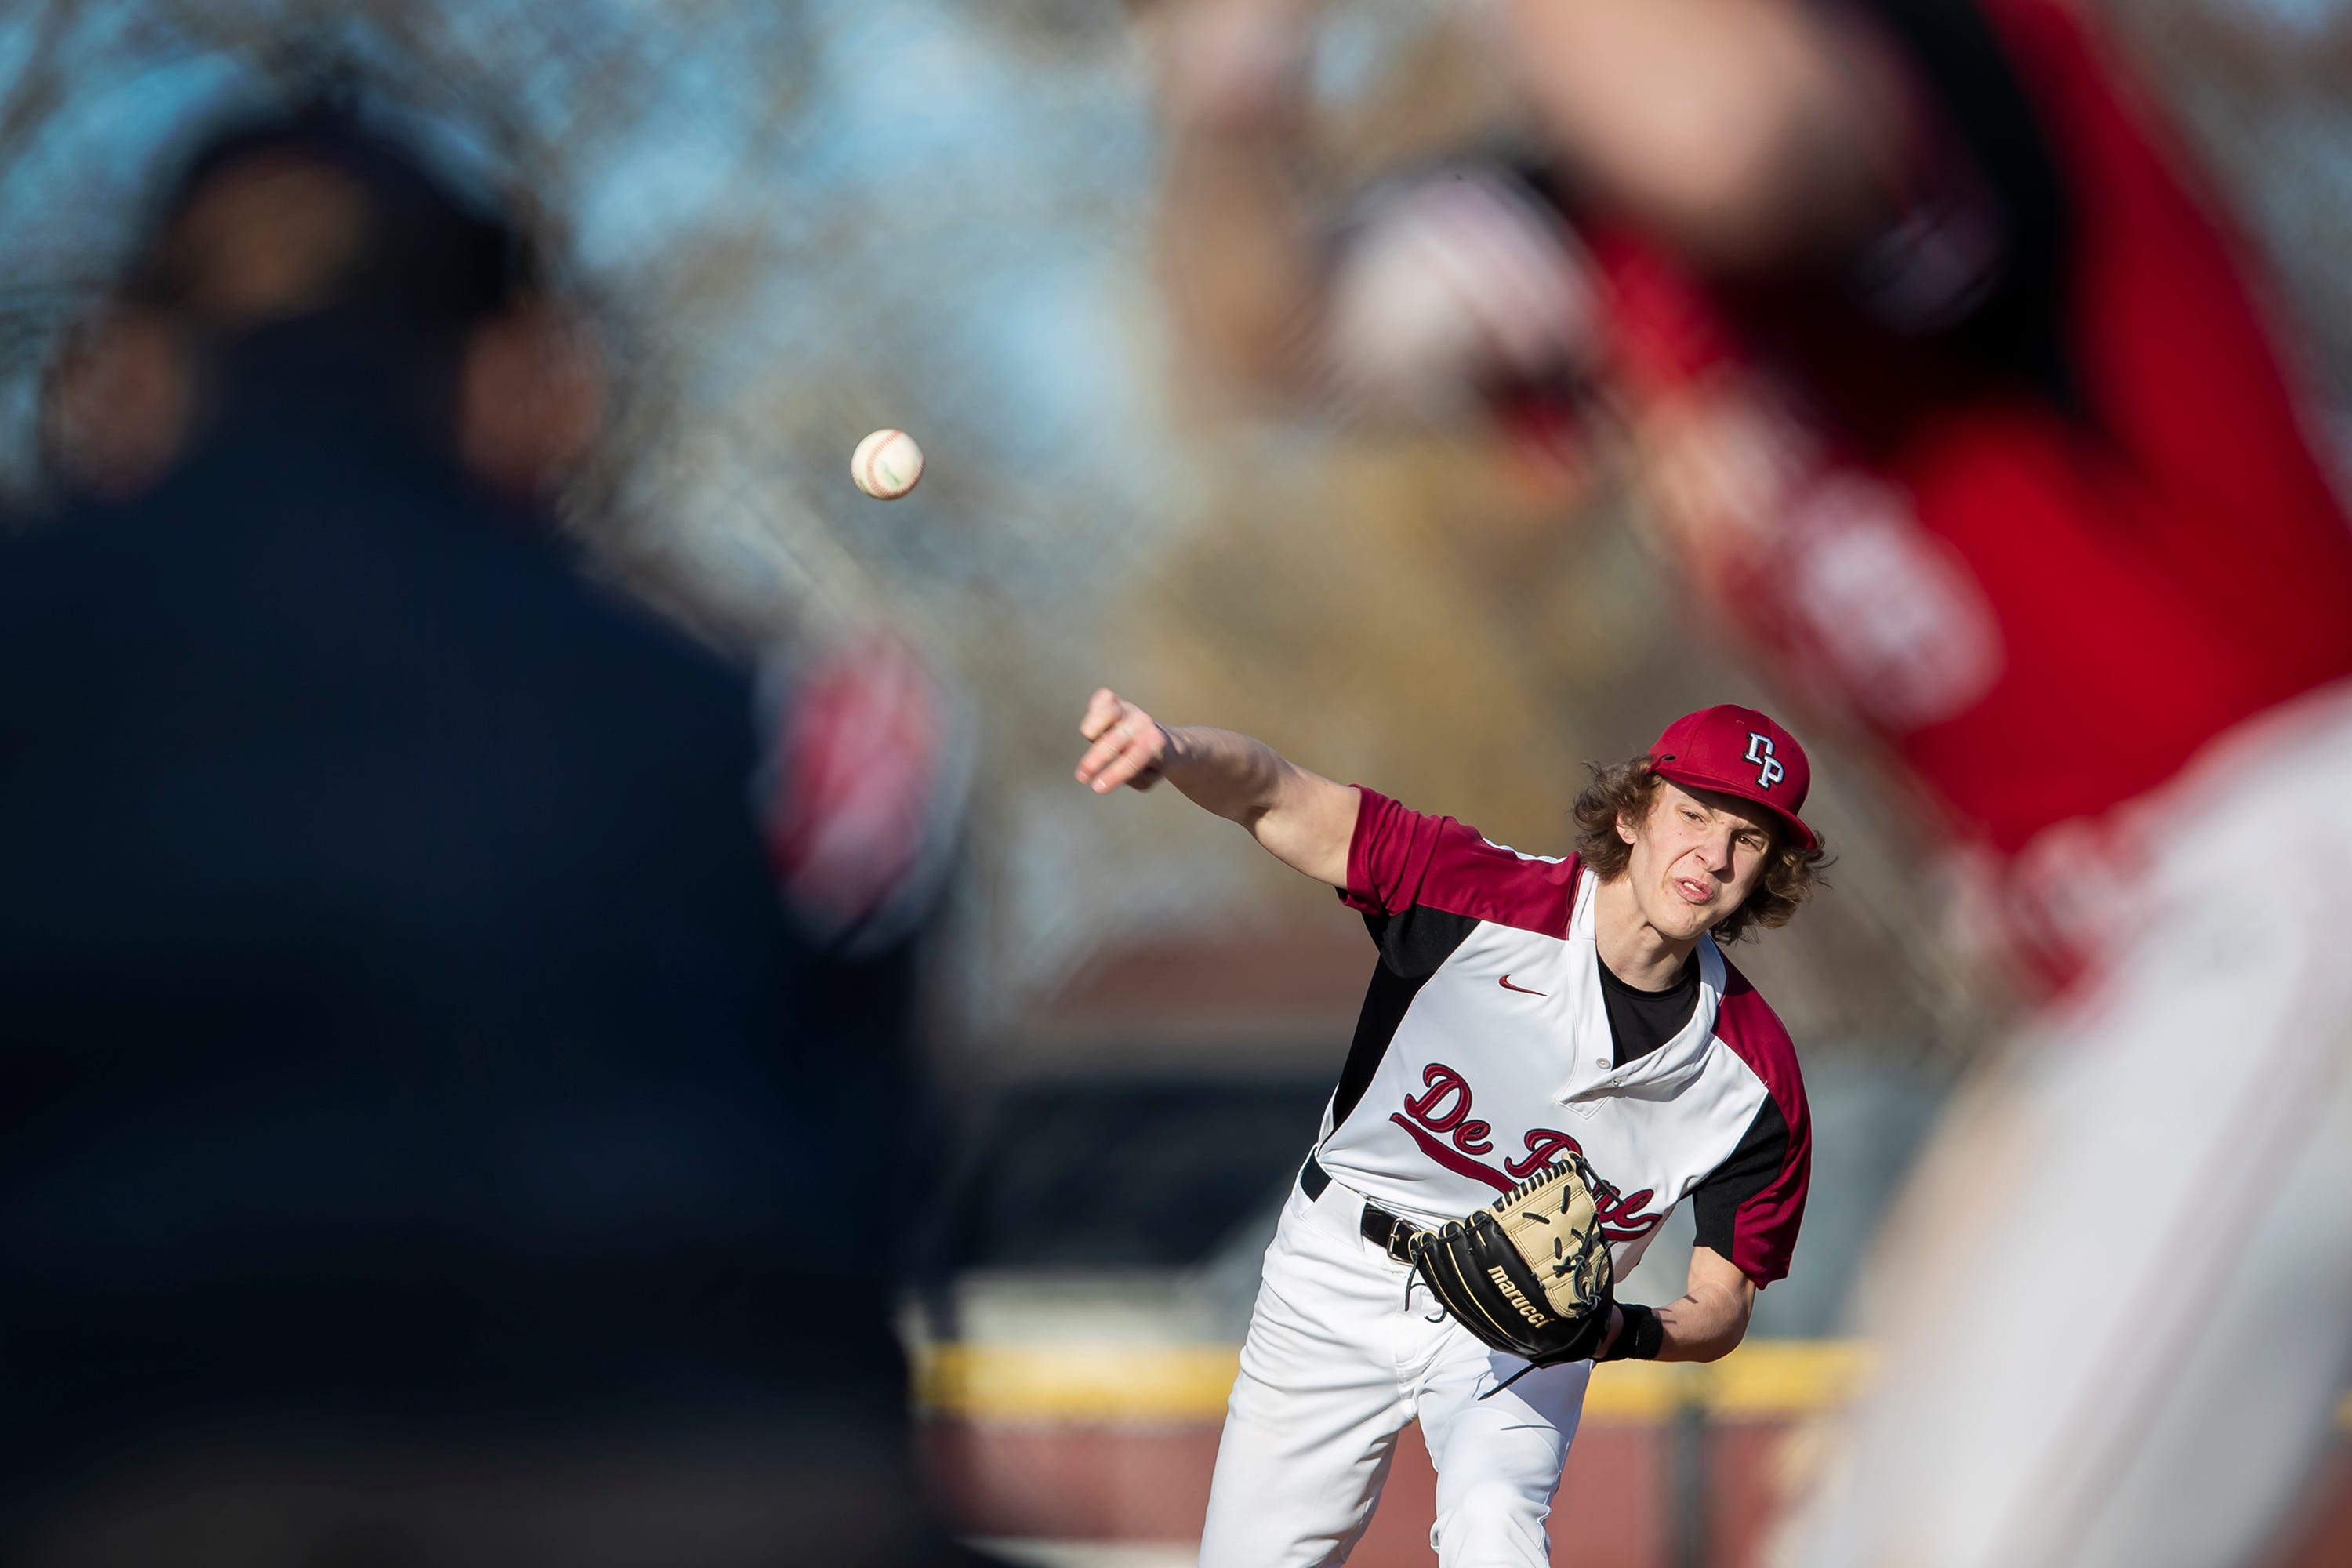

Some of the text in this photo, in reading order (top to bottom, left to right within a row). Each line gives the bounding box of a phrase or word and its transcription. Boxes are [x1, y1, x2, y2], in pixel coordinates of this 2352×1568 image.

[1741, 730, 1785, 792] DP
[1404, 1062, 1663, 1229] De Pre
[1487, 1265, 1555, 1329] marucci
